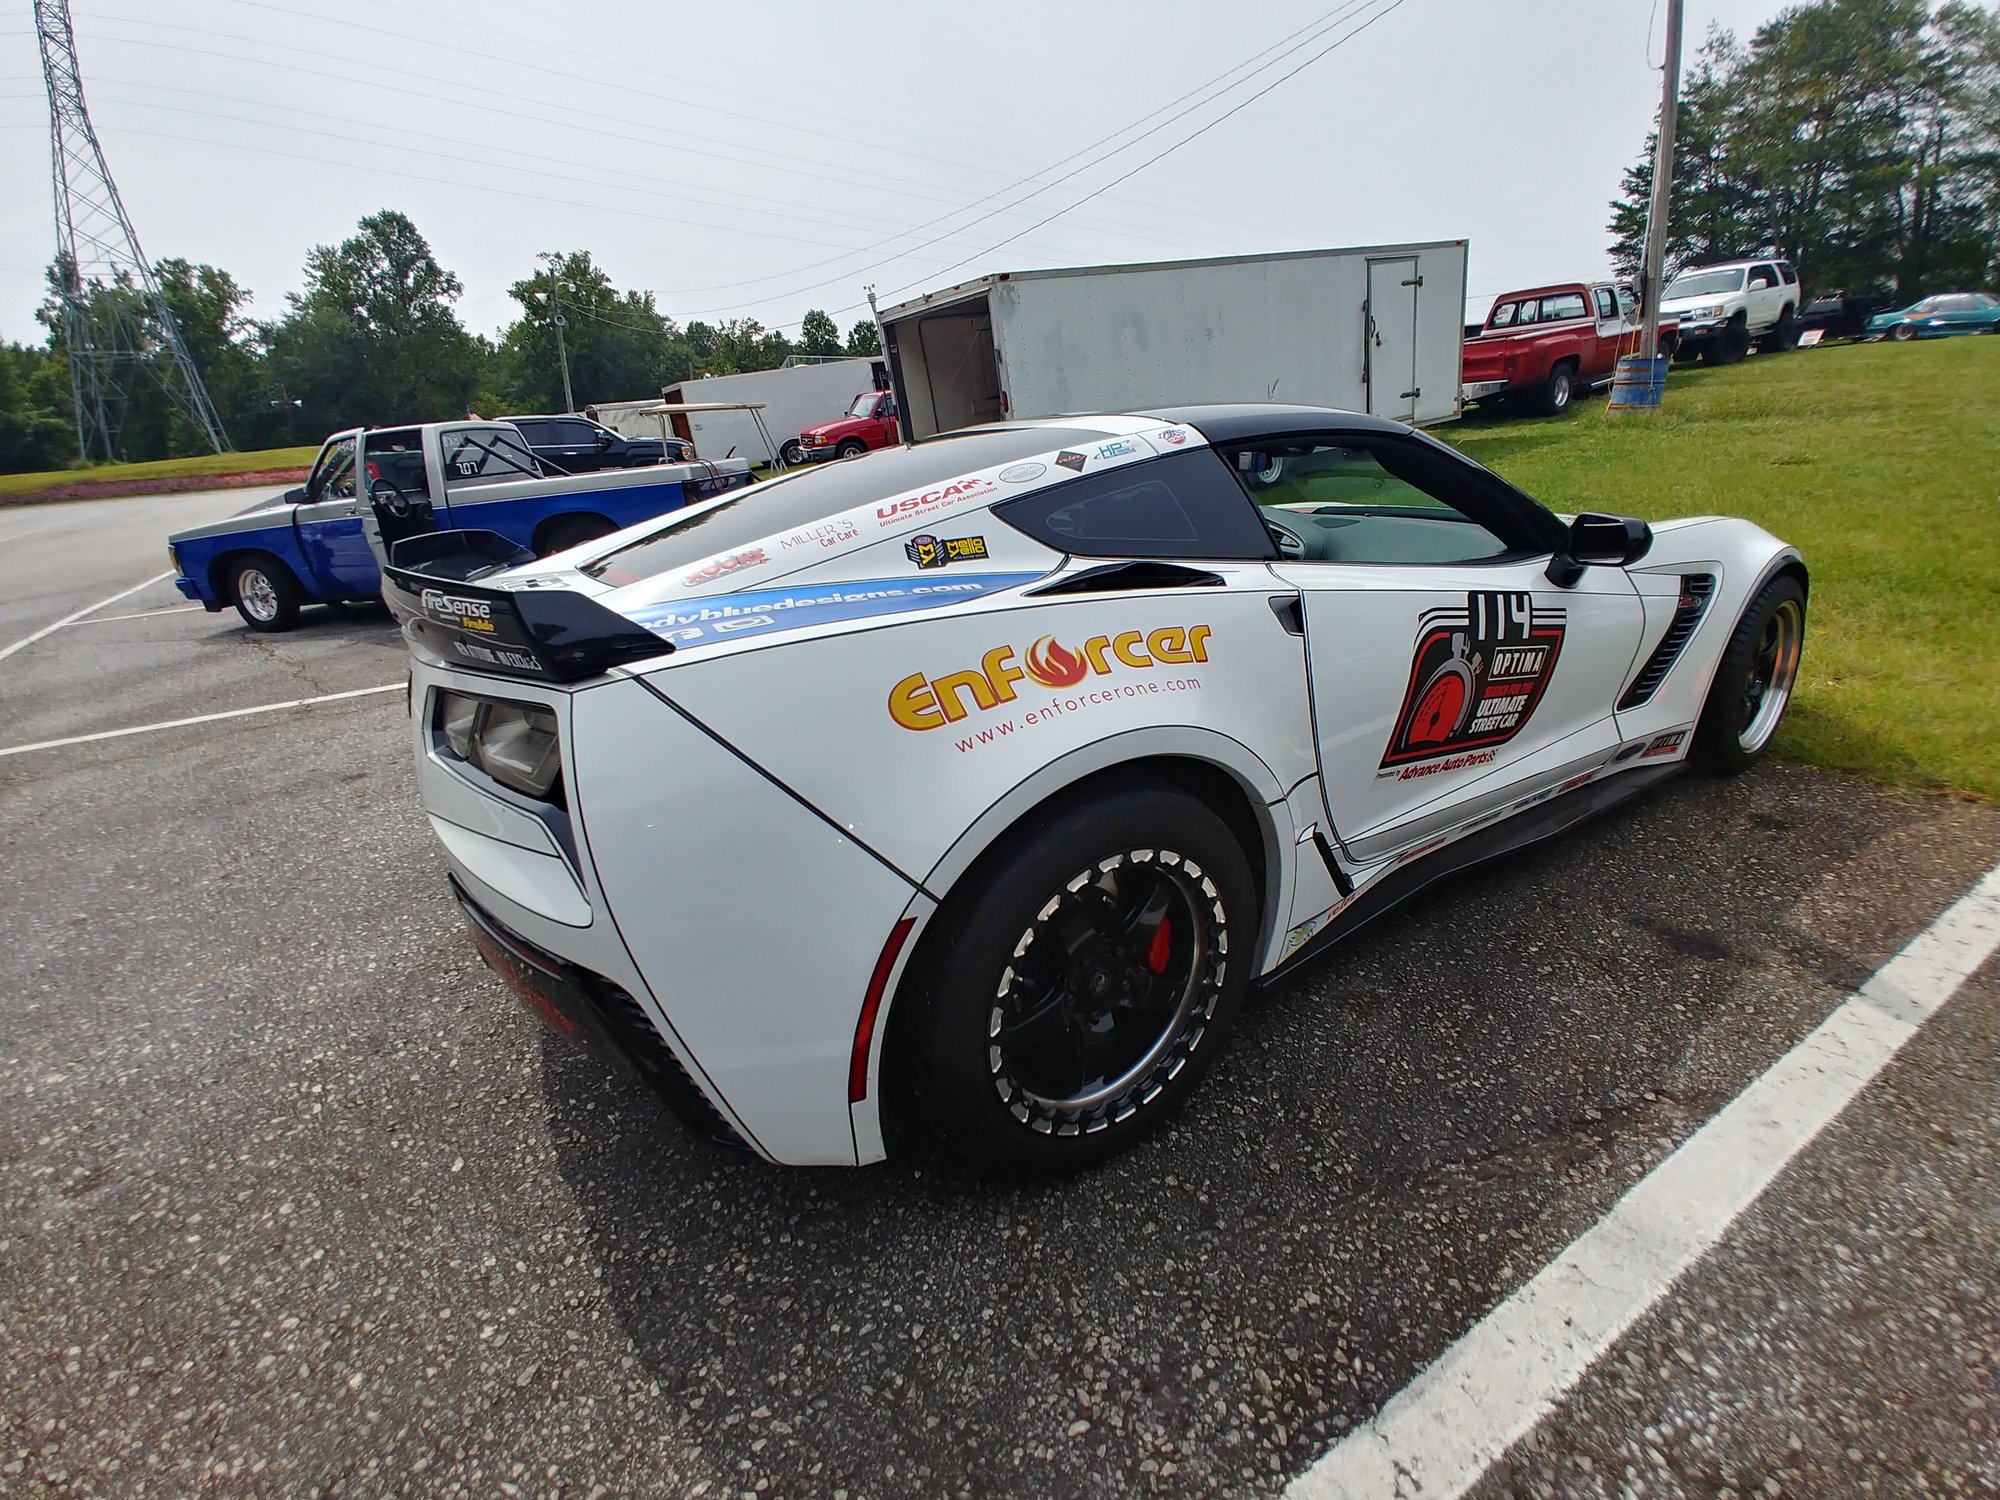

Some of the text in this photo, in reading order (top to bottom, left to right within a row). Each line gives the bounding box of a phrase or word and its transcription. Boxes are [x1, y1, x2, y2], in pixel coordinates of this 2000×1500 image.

[876, 484, 964, 520] USCA
[880, 486, 998, 528] Ultimate Street Car Association
[819, 527, 860, 548] Car Care
[1477, 594, 1531, 641] 114
[1492, 651, 1544, 676] OPTIMA
[954, 676, 1202, 753] www.enforcerone.com
[1476, 694, 1529, 718] ULTIMATE
[1468, 713, 1519, 734] STREET CAR
[1397, 765, 1441, 782] Advance
[1439, 758, 1466, 773] Auto
[1462, 752, 1490, 767] Parts
